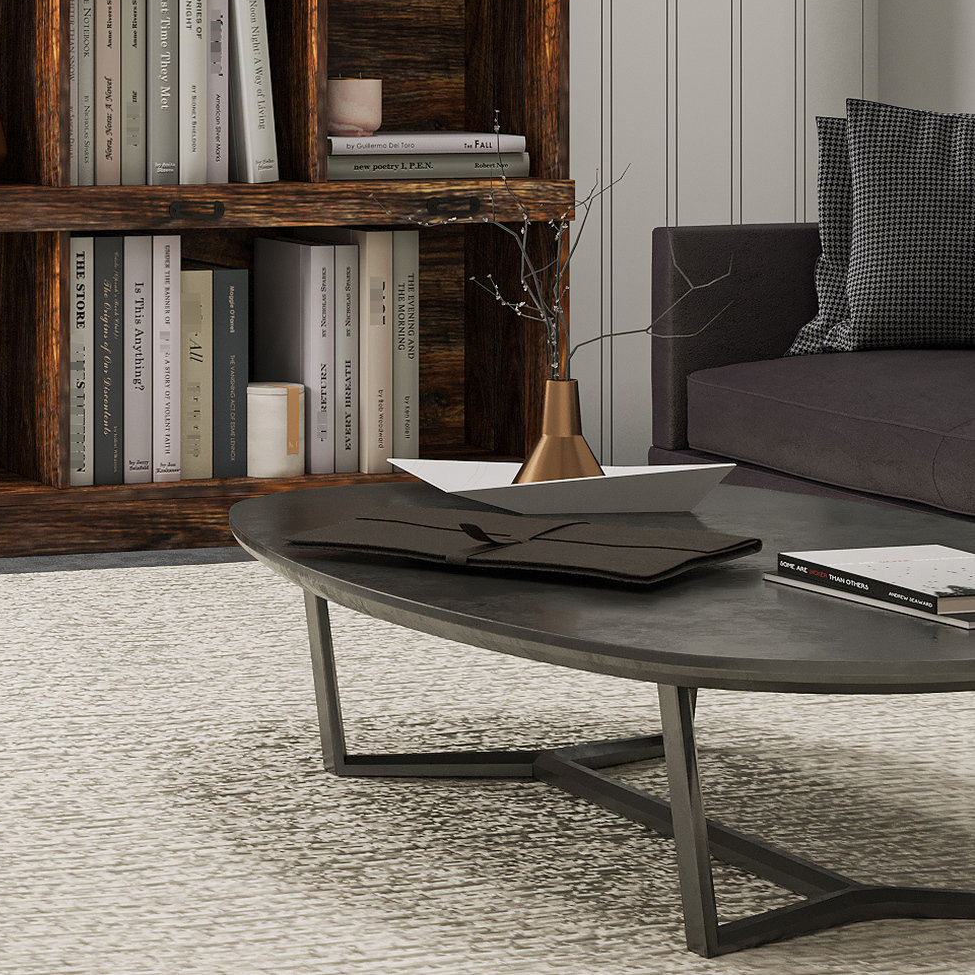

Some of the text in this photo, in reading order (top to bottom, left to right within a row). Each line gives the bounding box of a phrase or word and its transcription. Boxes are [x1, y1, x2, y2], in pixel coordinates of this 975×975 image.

[248, 0, 259, 23] Noon
[160, 16, 171, 48] Time
[158, 51, 171, 82] They
[254, 66, 264, 86] Way
[160, 86, 171, 110] Met
[256, 88, 266, 99] of
[257, 100, 267, 130] Living
[353, 163, 370, 171] new
[372, 163, 399, 171] poetry
[76, 251, 86, 279] THE
[102, 279, 111, 298] The
[76, 283, 86, 329] STORE
[397, 282, 405, 351] THE MORNING
[407, 273, 415, 360] THE EVENING AND
[99, 302, 111, 339] Origins
[99, 341, 111, 353] of
[133, 281, 145, 391] Is This Anything?
[189, 338, 204, 363] All
[102, 355, 111, 374] Our
[828, 573, 845, 585] THAN
[845, 578, 869, 591] OTHERS
